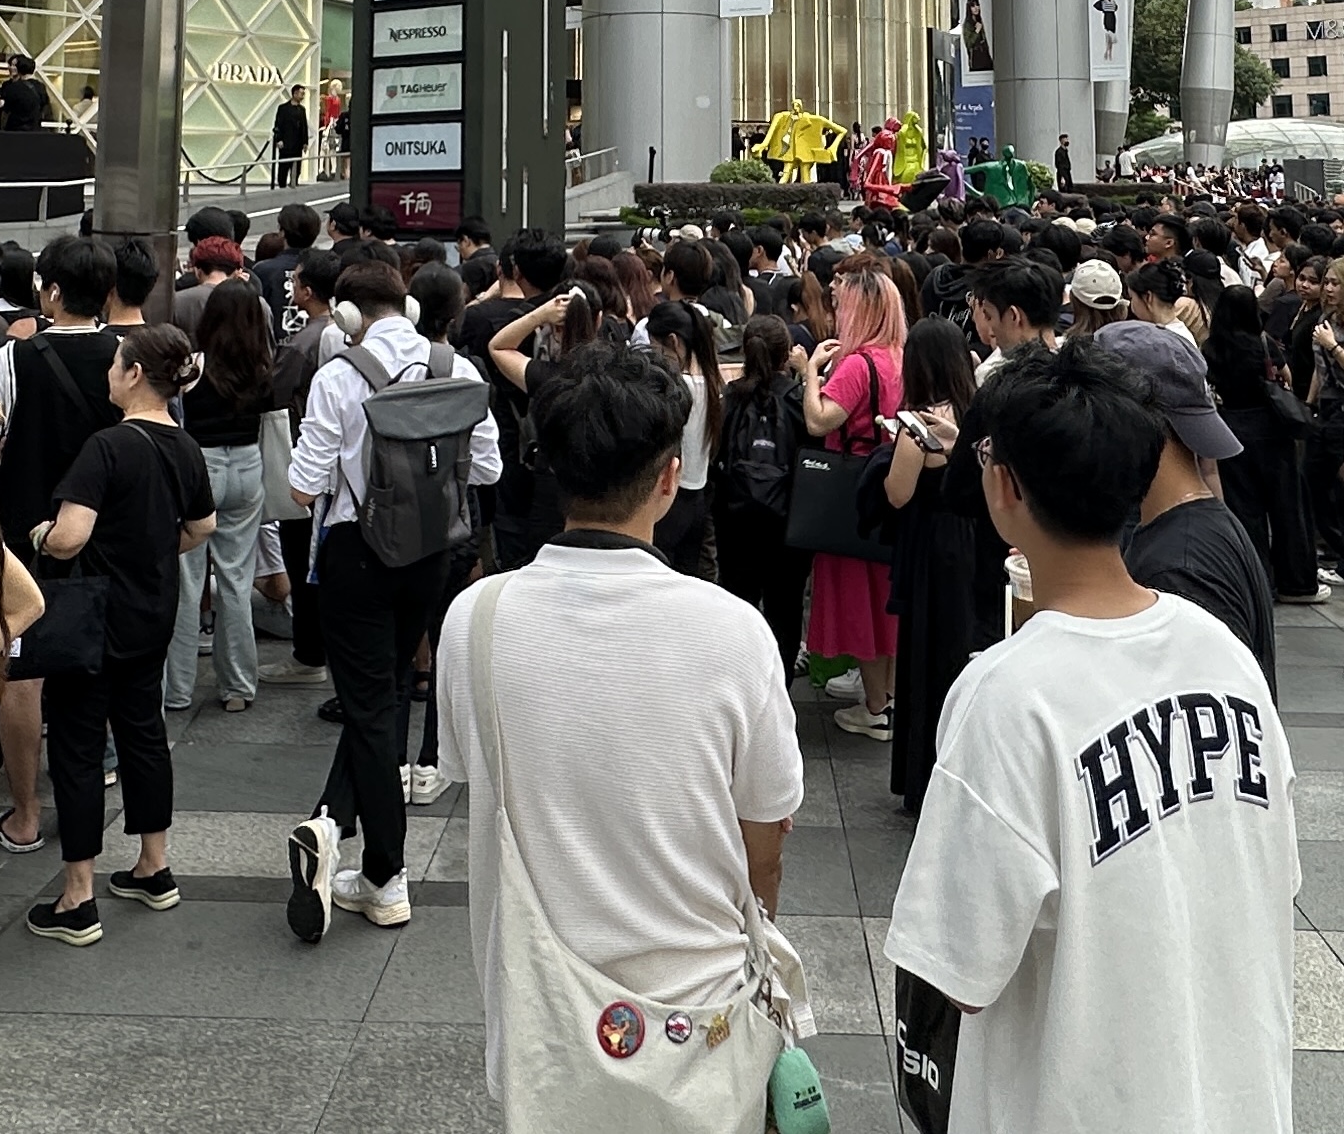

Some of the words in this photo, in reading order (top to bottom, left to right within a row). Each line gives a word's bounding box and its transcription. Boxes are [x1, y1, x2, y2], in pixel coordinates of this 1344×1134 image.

[389, 26, 446, 42] NESPRESSO
[213, 62, 284, 85] PRADA
[385, 139, 447, 156] ONITSUKA
[1075, 691, 1270, 867] HYPE
